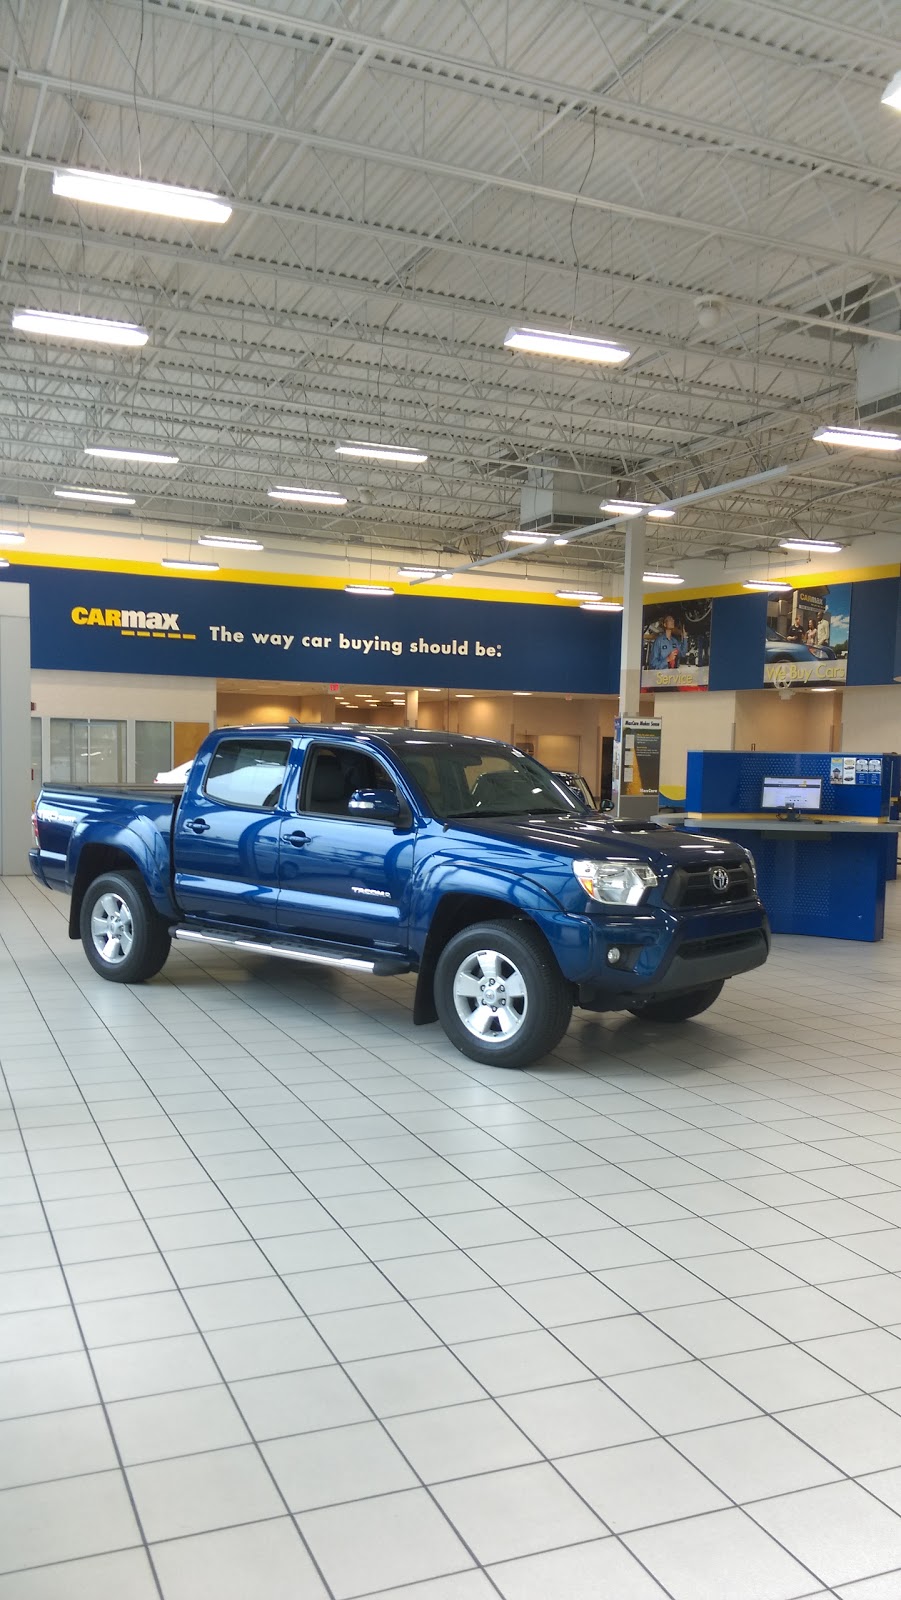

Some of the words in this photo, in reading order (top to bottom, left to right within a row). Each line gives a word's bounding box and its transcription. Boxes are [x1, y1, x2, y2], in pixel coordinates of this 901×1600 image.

[209, 626, 244, 643] The
[252, 633, 295, 650] way
[301, 635, 332, 648] car
[339, 633, 402, 656] buying
[410, 638, 468, 656] should
[655, 671, 693, 685] Service
[766, 666, 787, 681] We
[790, 666, 812, 684] Buy
[815, 664, 845, 679] Cars
